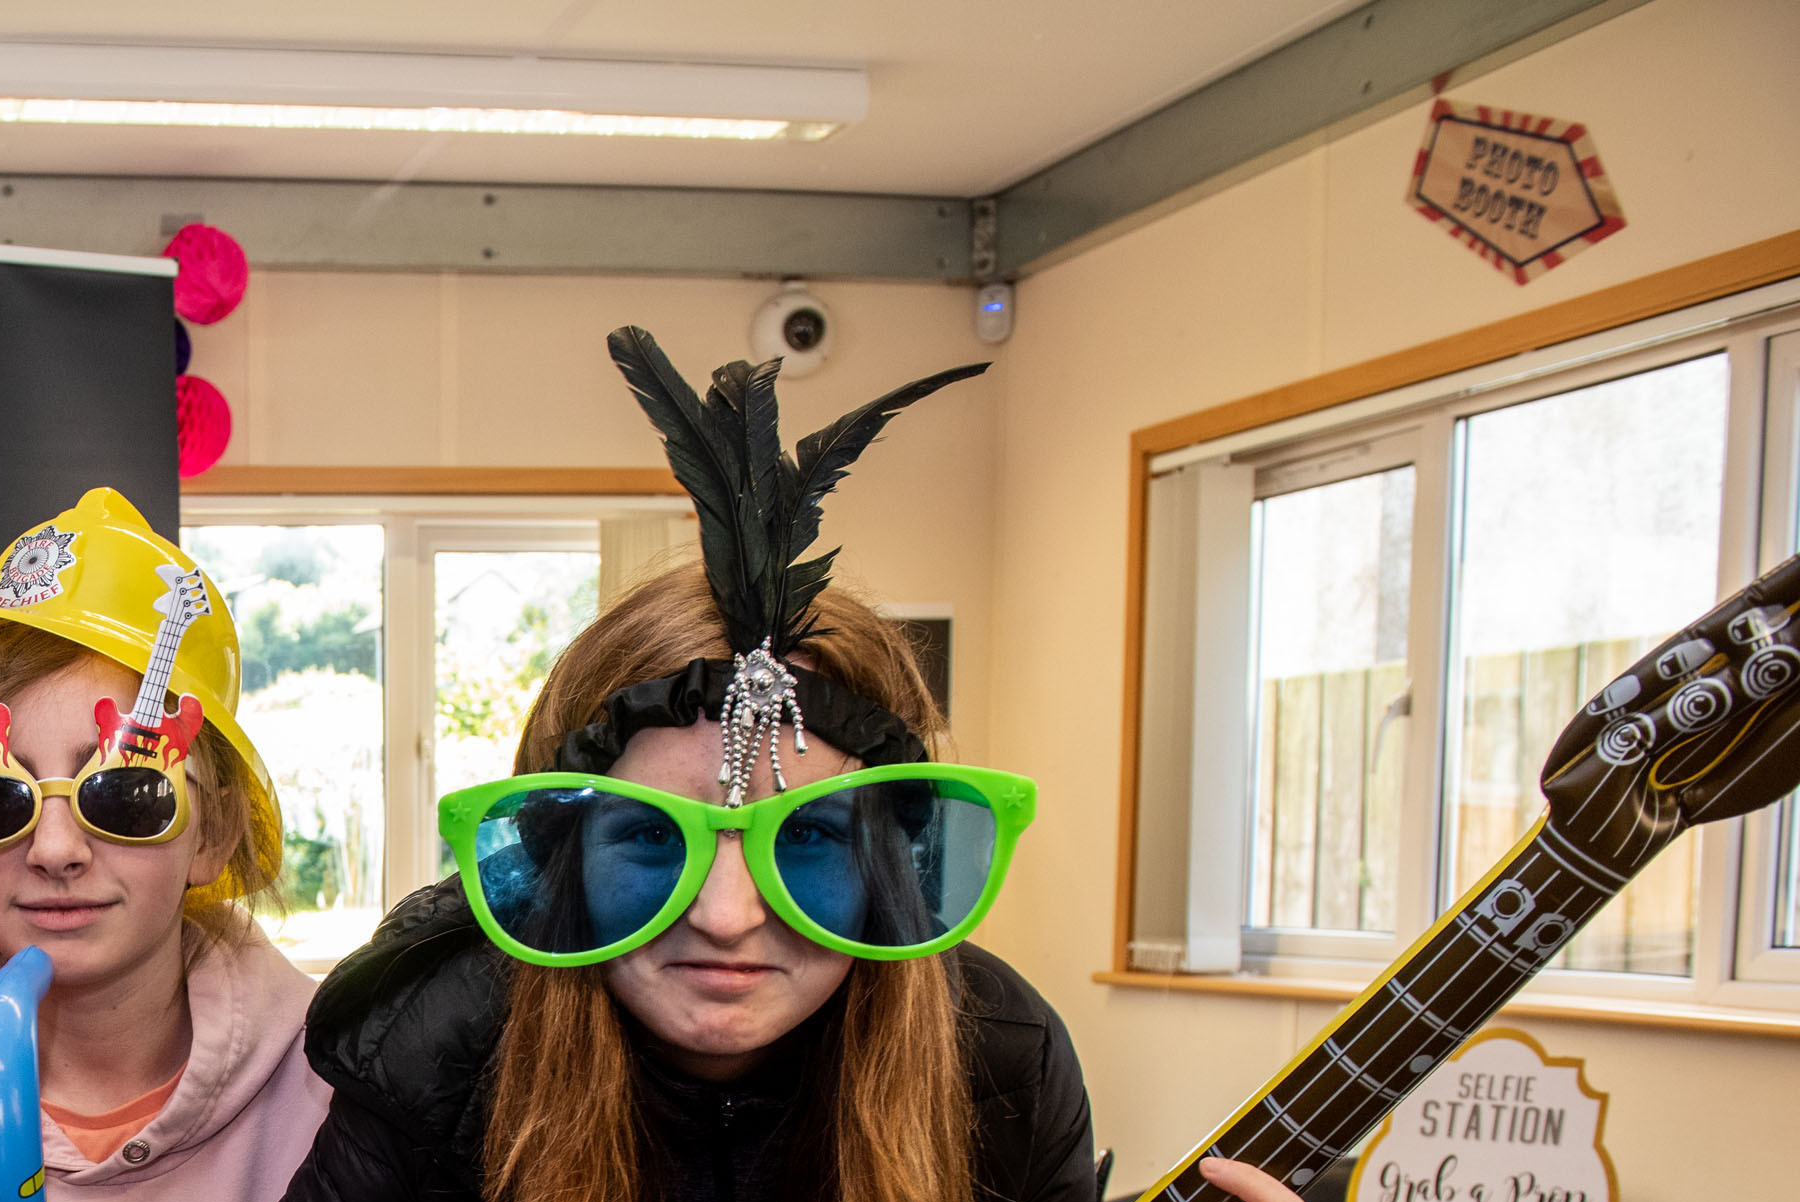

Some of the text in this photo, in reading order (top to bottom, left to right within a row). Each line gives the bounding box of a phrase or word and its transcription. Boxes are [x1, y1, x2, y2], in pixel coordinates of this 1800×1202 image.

[1465, 136, 1560, 196] PHOTO
[1453, 176, 1547, 239] BOOTH
[27, 539, 54, 550] FIRE
[9, 563, 53, 583] BRIGADE
[1458, 1072, 1537, 1103] SELFIE
[1419, 1100, 1566, 1146] STATION
